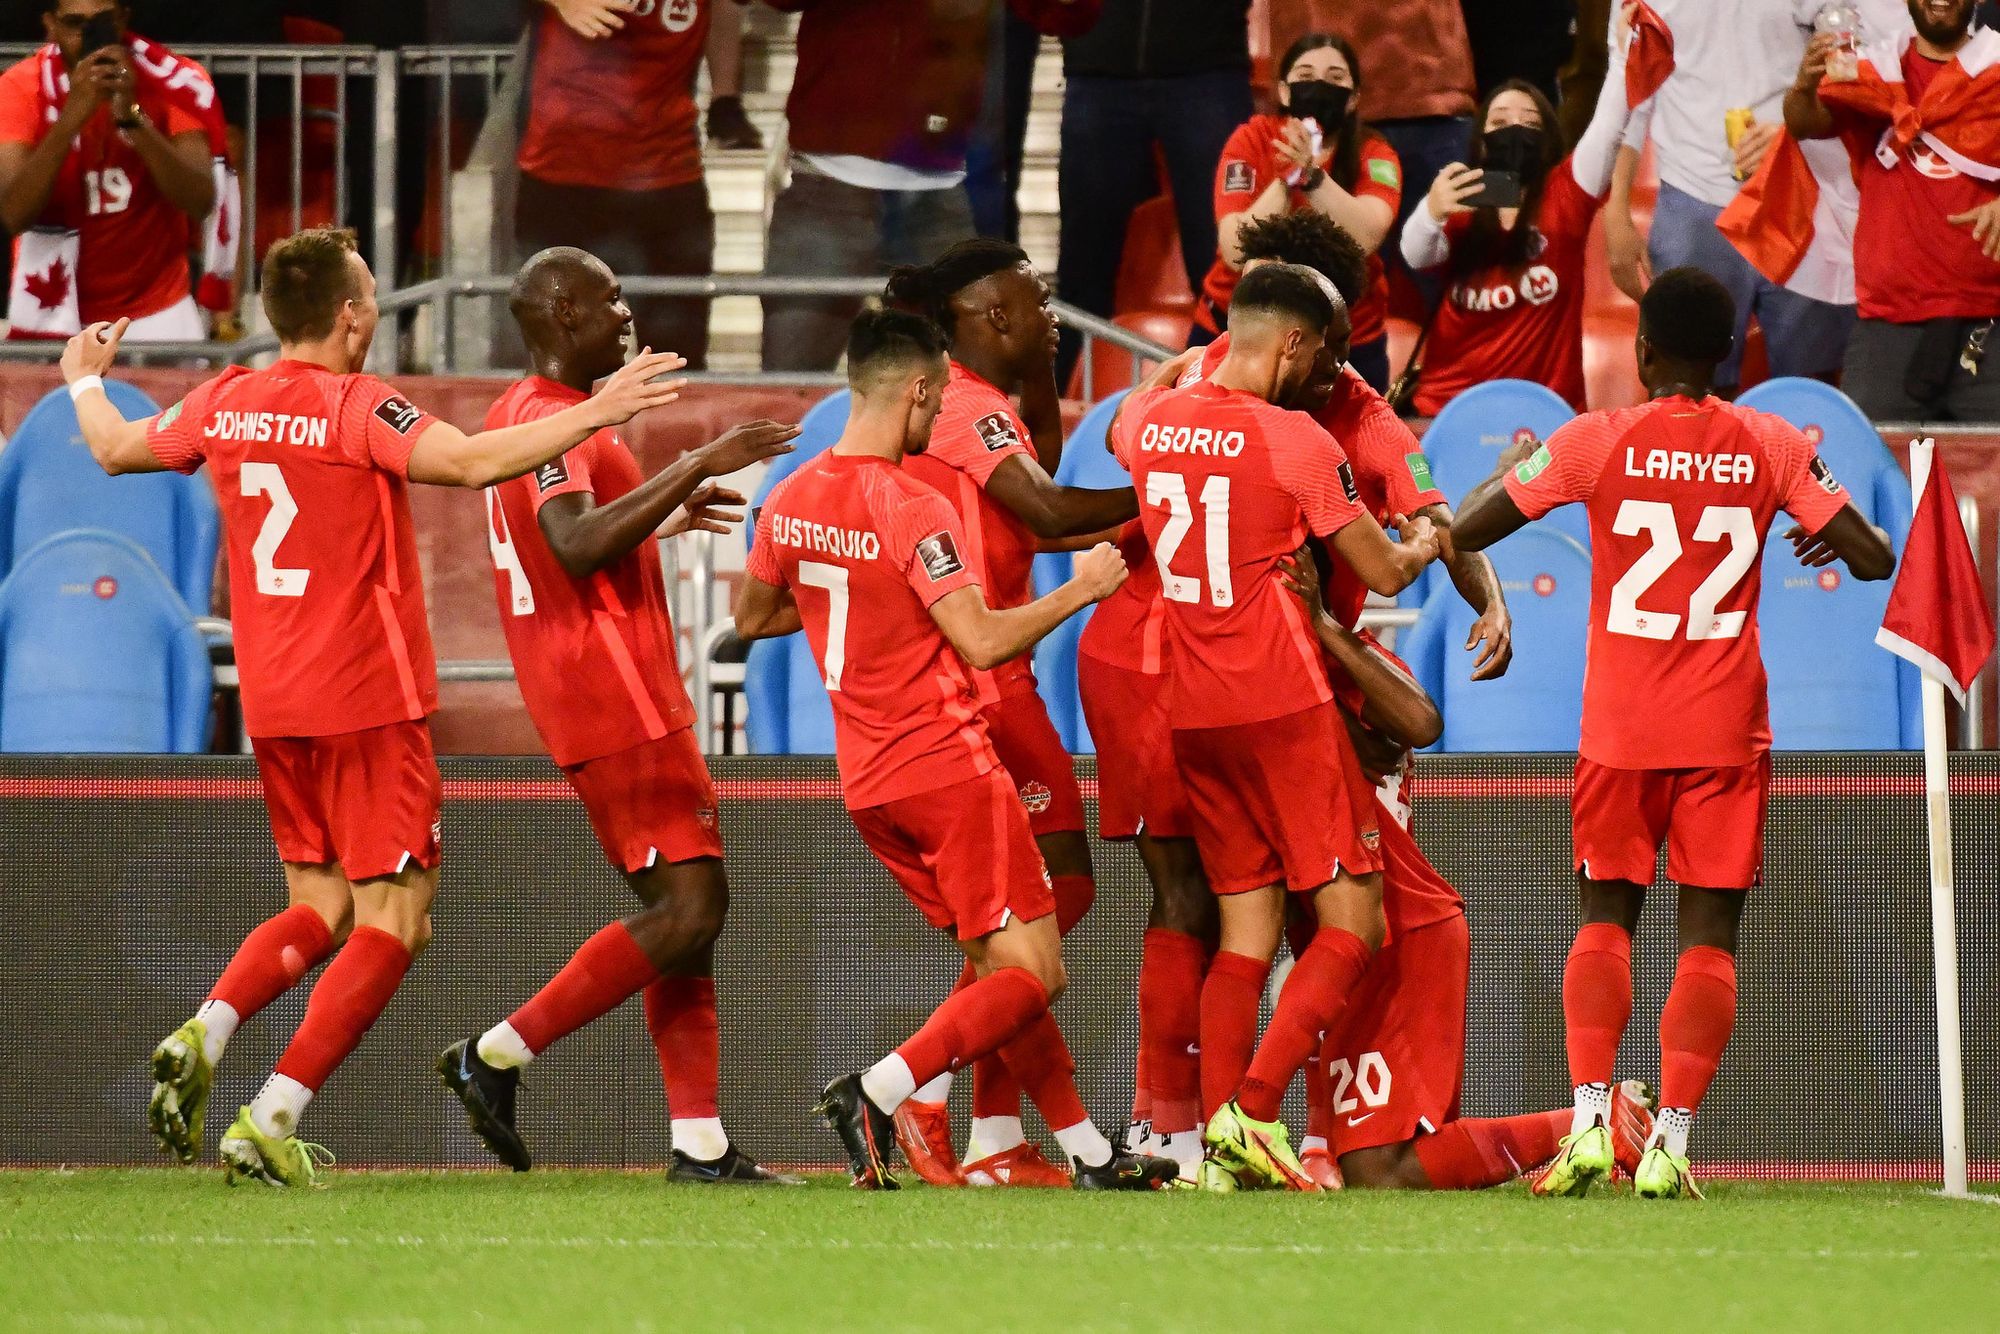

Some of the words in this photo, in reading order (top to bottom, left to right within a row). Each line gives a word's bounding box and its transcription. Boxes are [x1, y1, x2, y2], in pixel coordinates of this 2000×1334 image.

[85, 167, 132, 215] 19
[1451, 284, 1516, 311] MO
[203, 411, 328, 447] JOHNSTON
[1141, 423, 1245, 457] OSORIO
[1625, 447, 1755, 484] LARYEA
[240, 462, 311, 596] 2
[484, 484, 536, 616] 4
[773, 513, 880, 560] EUSTAQUIO
[1146, 471, 1234, 608] 21
[1606, 499, 1759, 641] 22
[798, 560, 849, 691] 7
[1329, 1051, 1392, 1115] 20
